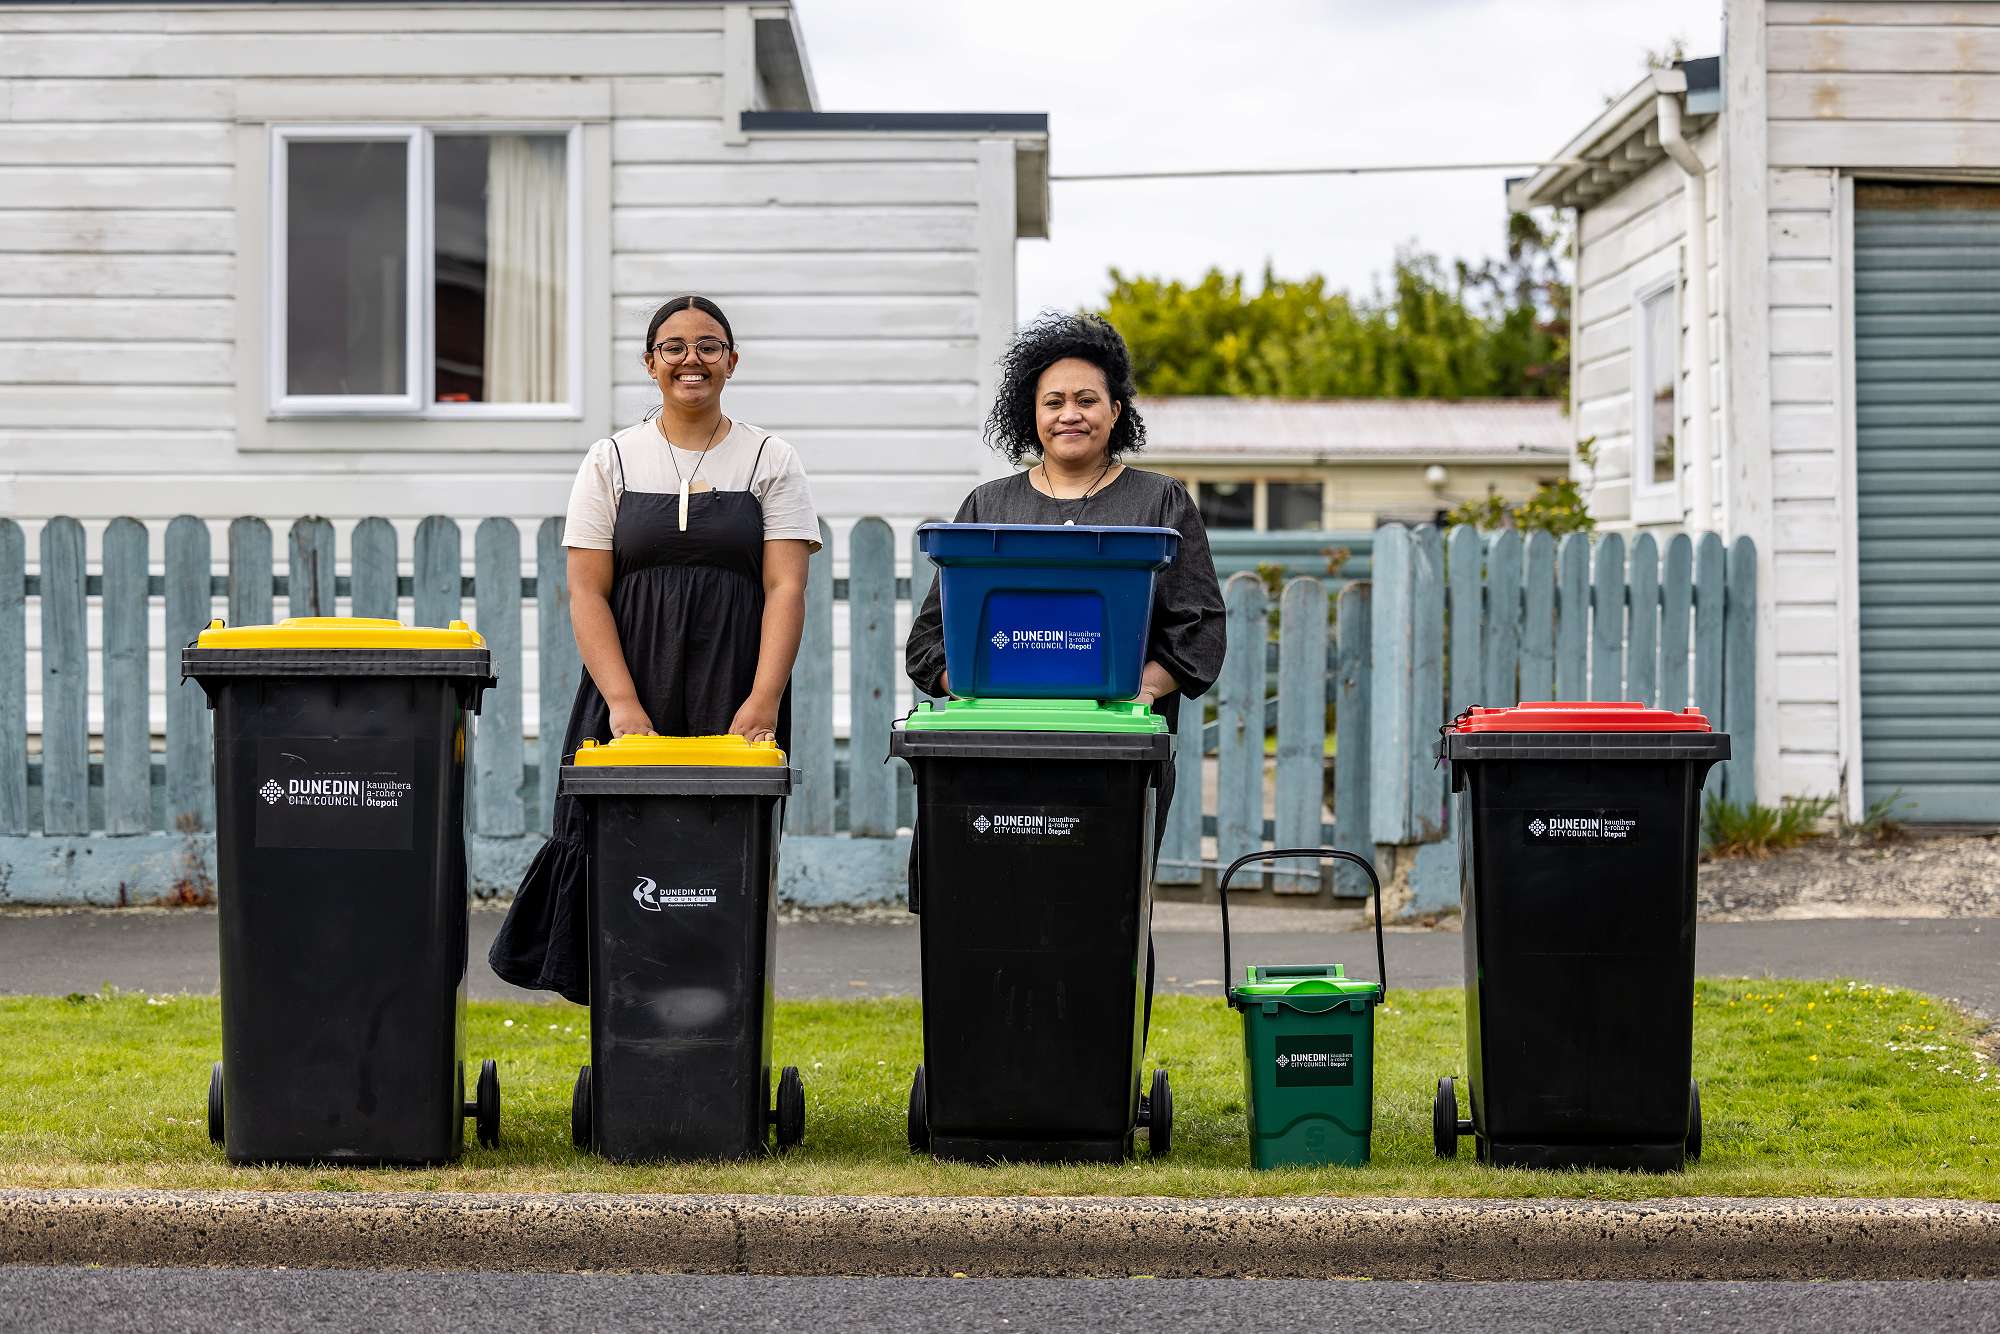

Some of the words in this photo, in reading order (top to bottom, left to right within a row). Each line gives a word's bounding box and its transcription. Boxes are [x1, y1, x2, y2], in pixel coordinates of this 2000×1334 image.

[1012, 630, 1064, 642] DUNEDIN
[1012, 642, 1030, 650] CITY
[1031, 642, 1063, 650] COUNCIL
[289, 779, 359, 795] DUNEDIN
[366, 781, 412, 790] kaunihera
[366, 789, 395, 797] a-rohe
[288, 795, 312, 806] CITY
[314, 796, 358, 807] COUNCIL
[993, 815, 1043, 827] DUNEDIN
[1549, 818, 1599, 830] DUNEDIN
[993, 826, 1010, 834] CITY
[1011, 827, 1043, 835] COUNCIL
[1567, 830, 1599, 838] COUNCIL
[698, 888, 717, 896] CITY
[1291, 1053, 1327, 1062] DUNEDIN
